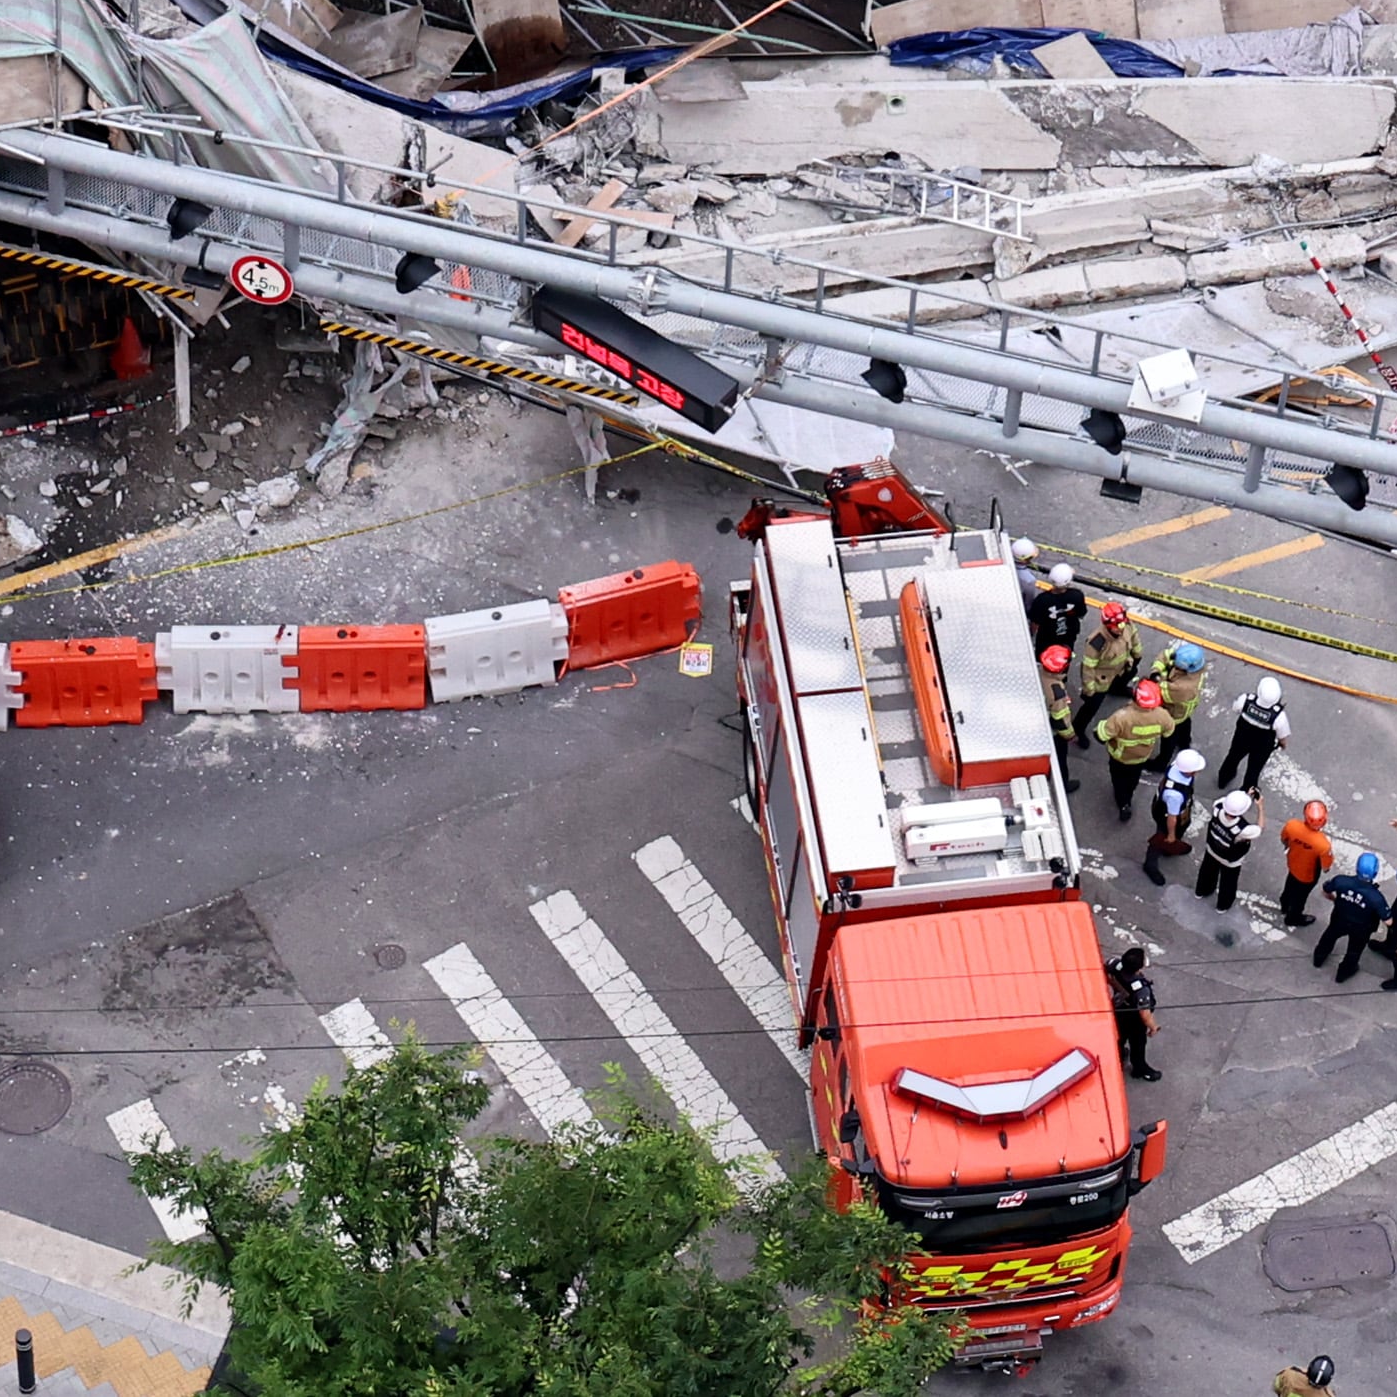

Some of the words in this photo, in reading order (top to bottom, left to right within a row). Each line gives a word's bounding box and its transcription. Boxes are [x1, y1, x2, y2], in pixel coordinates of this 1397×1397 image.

[242, 267, 281, 294] 4.5m
[561, 322, 633, 379] 건널목
[635, 367, 686, 410] 고장
[996, 1191, 1027, 1209] 119
[923, 1210, 955, 1221] 서울소방
